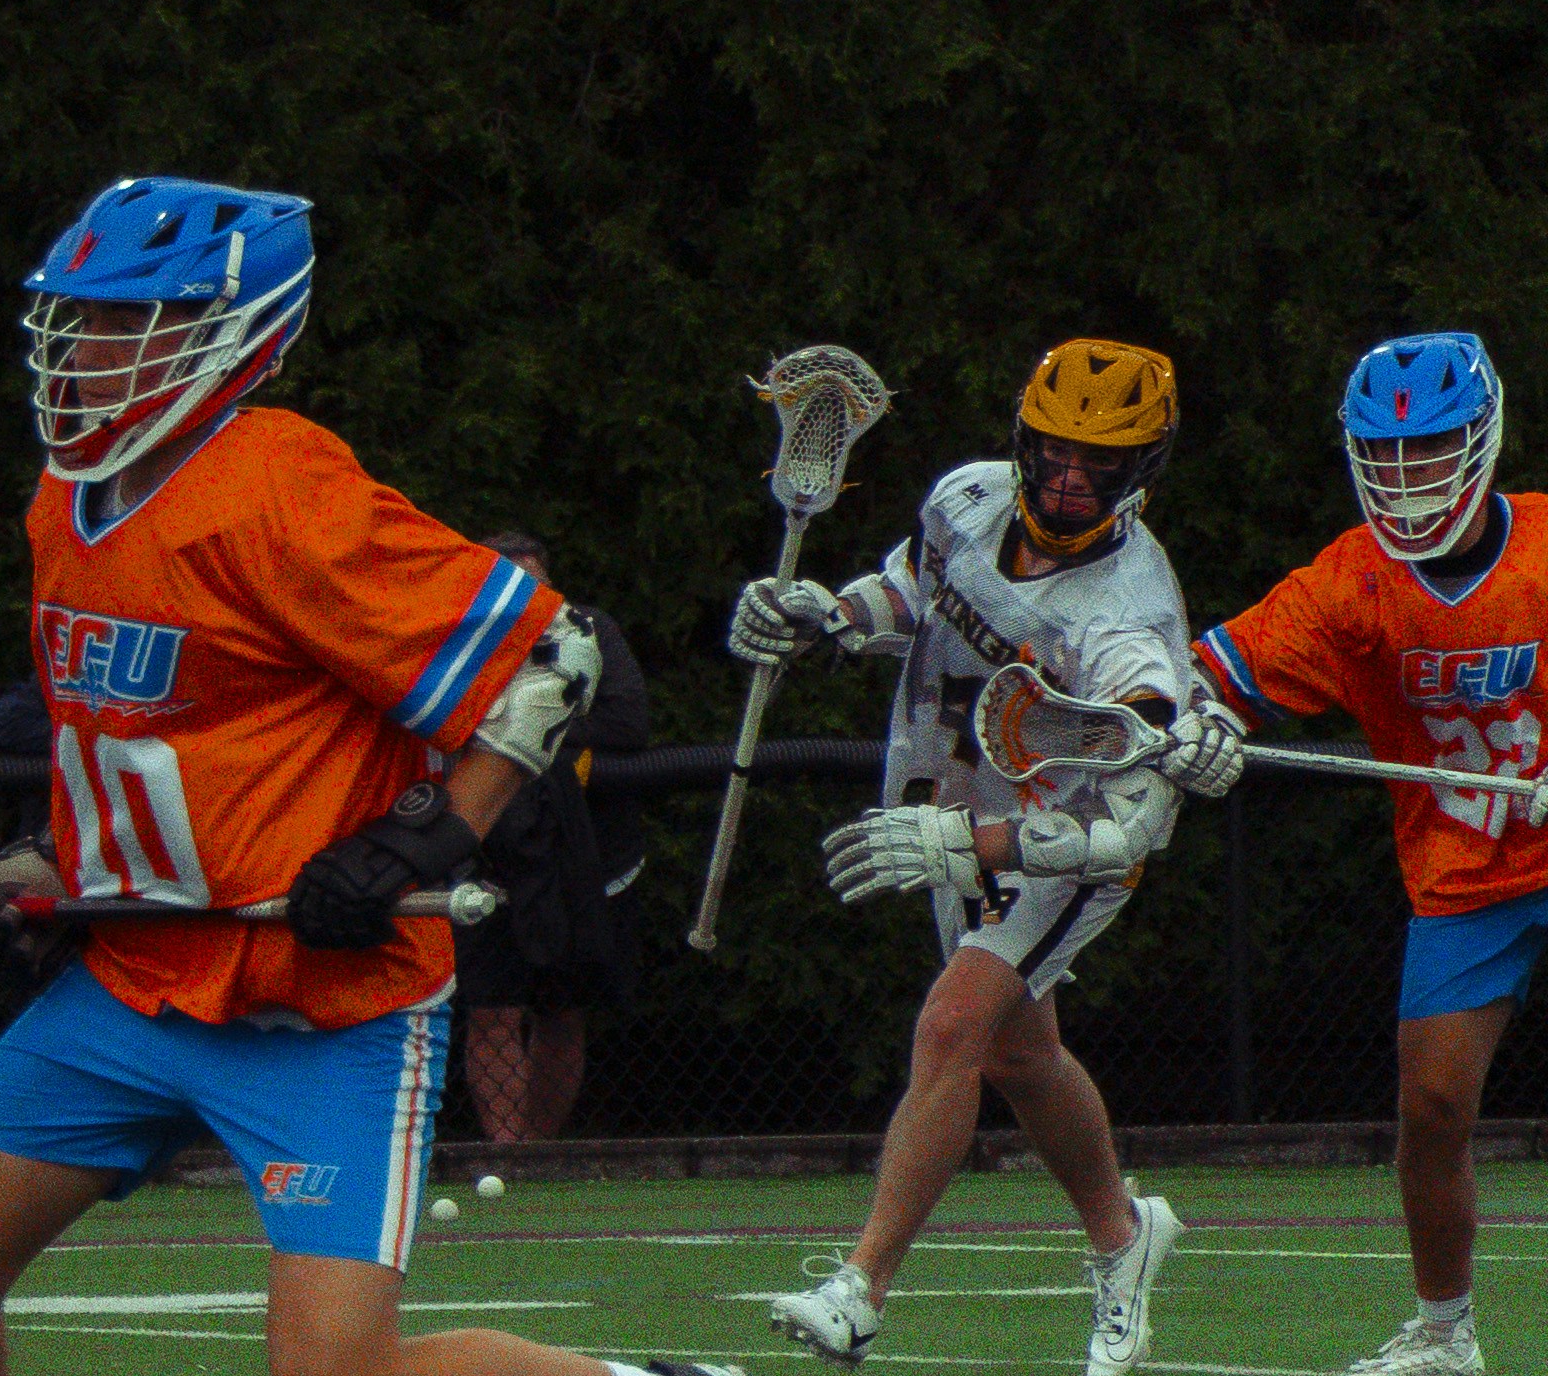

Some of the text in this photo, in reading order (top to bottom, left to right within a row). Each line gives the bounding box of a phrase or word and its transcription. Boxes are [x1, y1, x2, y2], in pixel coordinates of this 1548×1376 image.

[39, 602, 192, 703] ECU
[1401, 642, 1541, 701] ECU
[57, 723, 213, 909] 10
[260, 1161, 341, 1199] ECU
